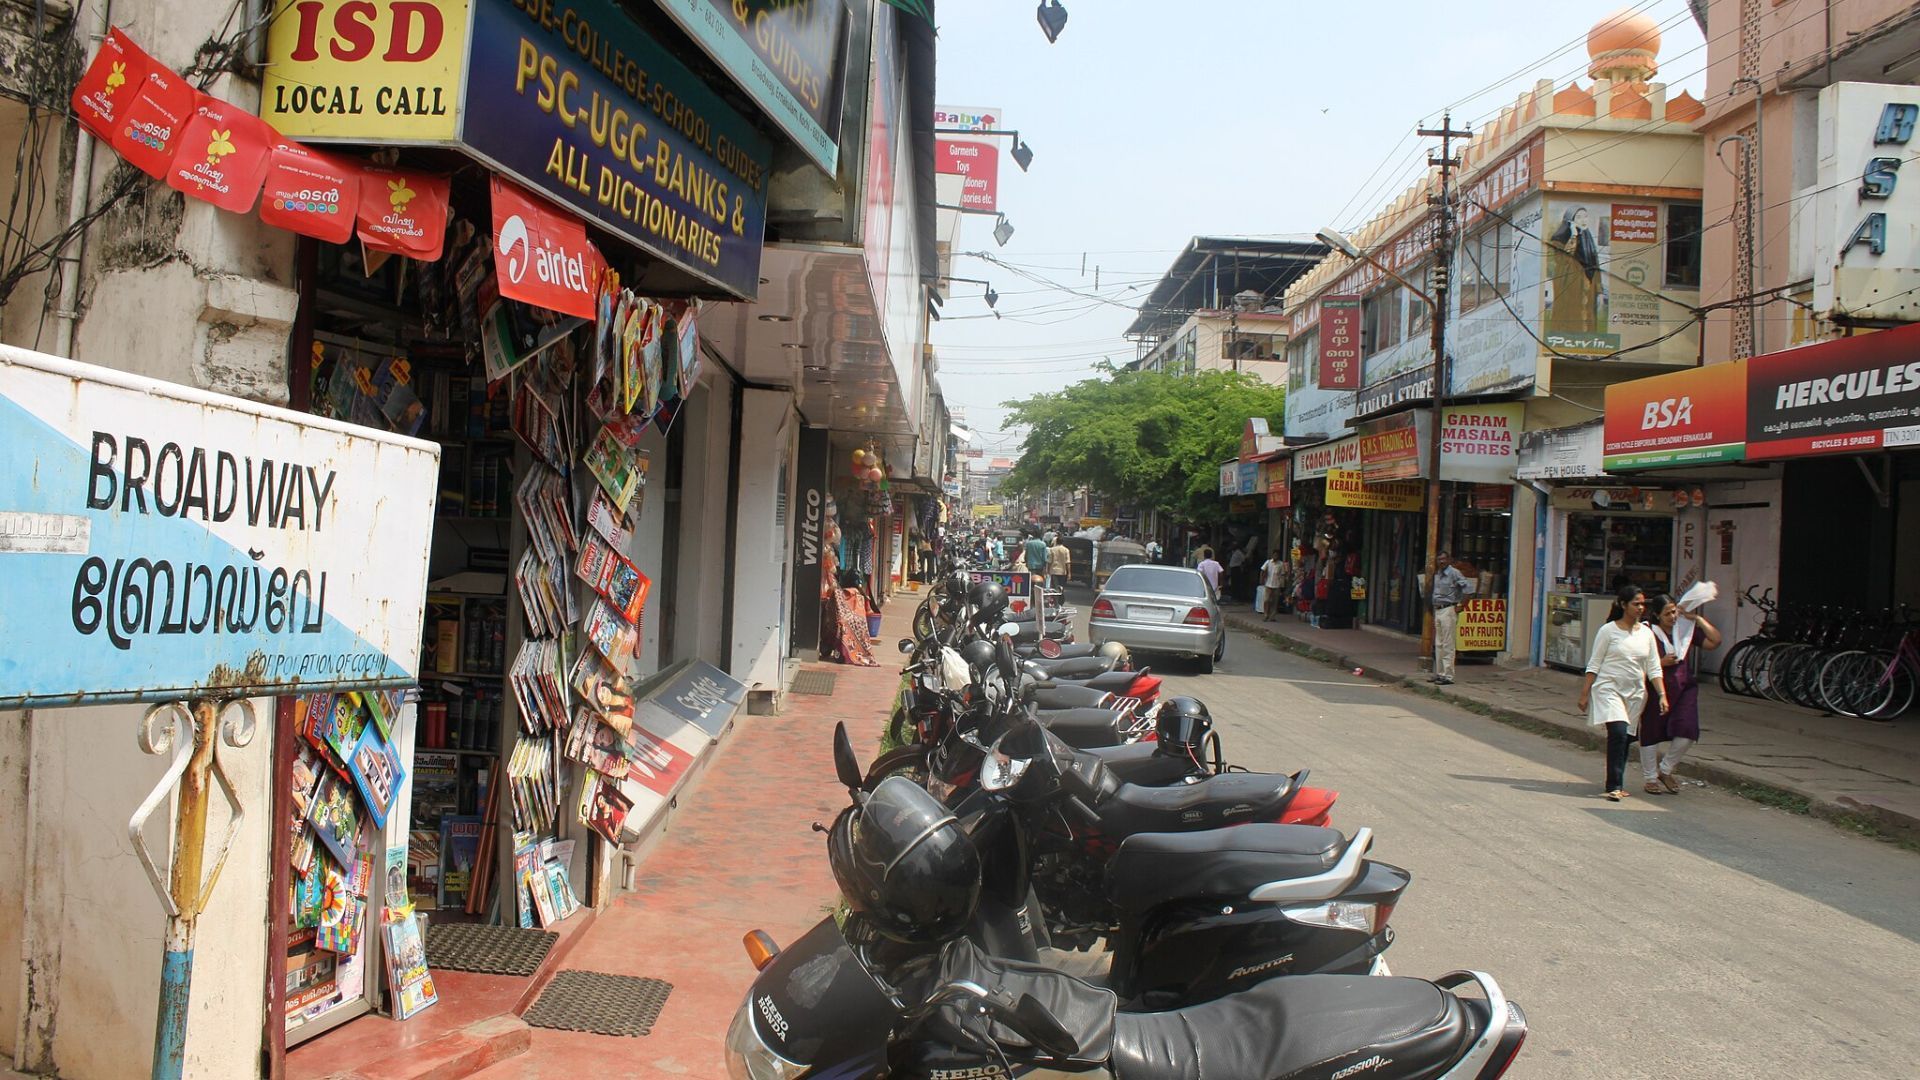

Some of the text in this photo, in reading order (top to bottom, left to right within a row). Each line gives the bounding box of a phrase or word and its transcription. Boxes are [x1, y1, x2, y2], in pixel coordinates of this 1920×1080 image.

[289, 1, 444, 62] ISD
[755, 10, 820, 110] GUIDES
[275, 85, 447, 115] LOCAL CALL
[207, 111, 222, 121] airtel
[935, 111, 980, 125] Baby
[515, 37, 728, 227] PSC-UGC-BANKS
[731, 193, 745, 237] &
[949, 144, 978, 157] Garments
[717, 135, 761, 192] GUIDES
[956, 160, 970, 173] Toys
[194, 163, 223, 183] വിഷു
[964, 178, 988, 191] tionery
[546, 138, 721, 266] ALL DICTIONARIES
[382, 213, 415, 230] വിഷു
[535, 237, 589, 294] airtel
[1775, 361, 1920, 410] HERCULES
[1357, 392, 1394, 416] CANARA
[1398, 377, 1435, 401] STORE
[1448, 414, 1508, 427] GARAM
[1641, 396, 1693, 430] BSA
[1442, 428, 1512, 442] MASALA
[1811, 437, 1842, 449] BICYCLES
[1849, 435, 1876, 446] SPARES
[1442, 441, 1511, 456] STORES
[1544, 465, 1586, 475] PEN HOUSE
[86, 430, 337, 532] BROADWAY
[1328, 480, 1359, 492] KERALA
[1684, 523, 1694, 560] PEN
[971, 573, 1011, 586] Baby
[1466, 613, 1504, 623] MASA
[1460, 626, 1503, 637] DRY FRUITS
[336, 653, 352, 674] OF
[352, 653, 389, 673] COCHIN
[758, 996, 786, 1043] HONDA
[764, 994, 789, 1031] HERO
[931, 1065, 1000, 1080] HERO
